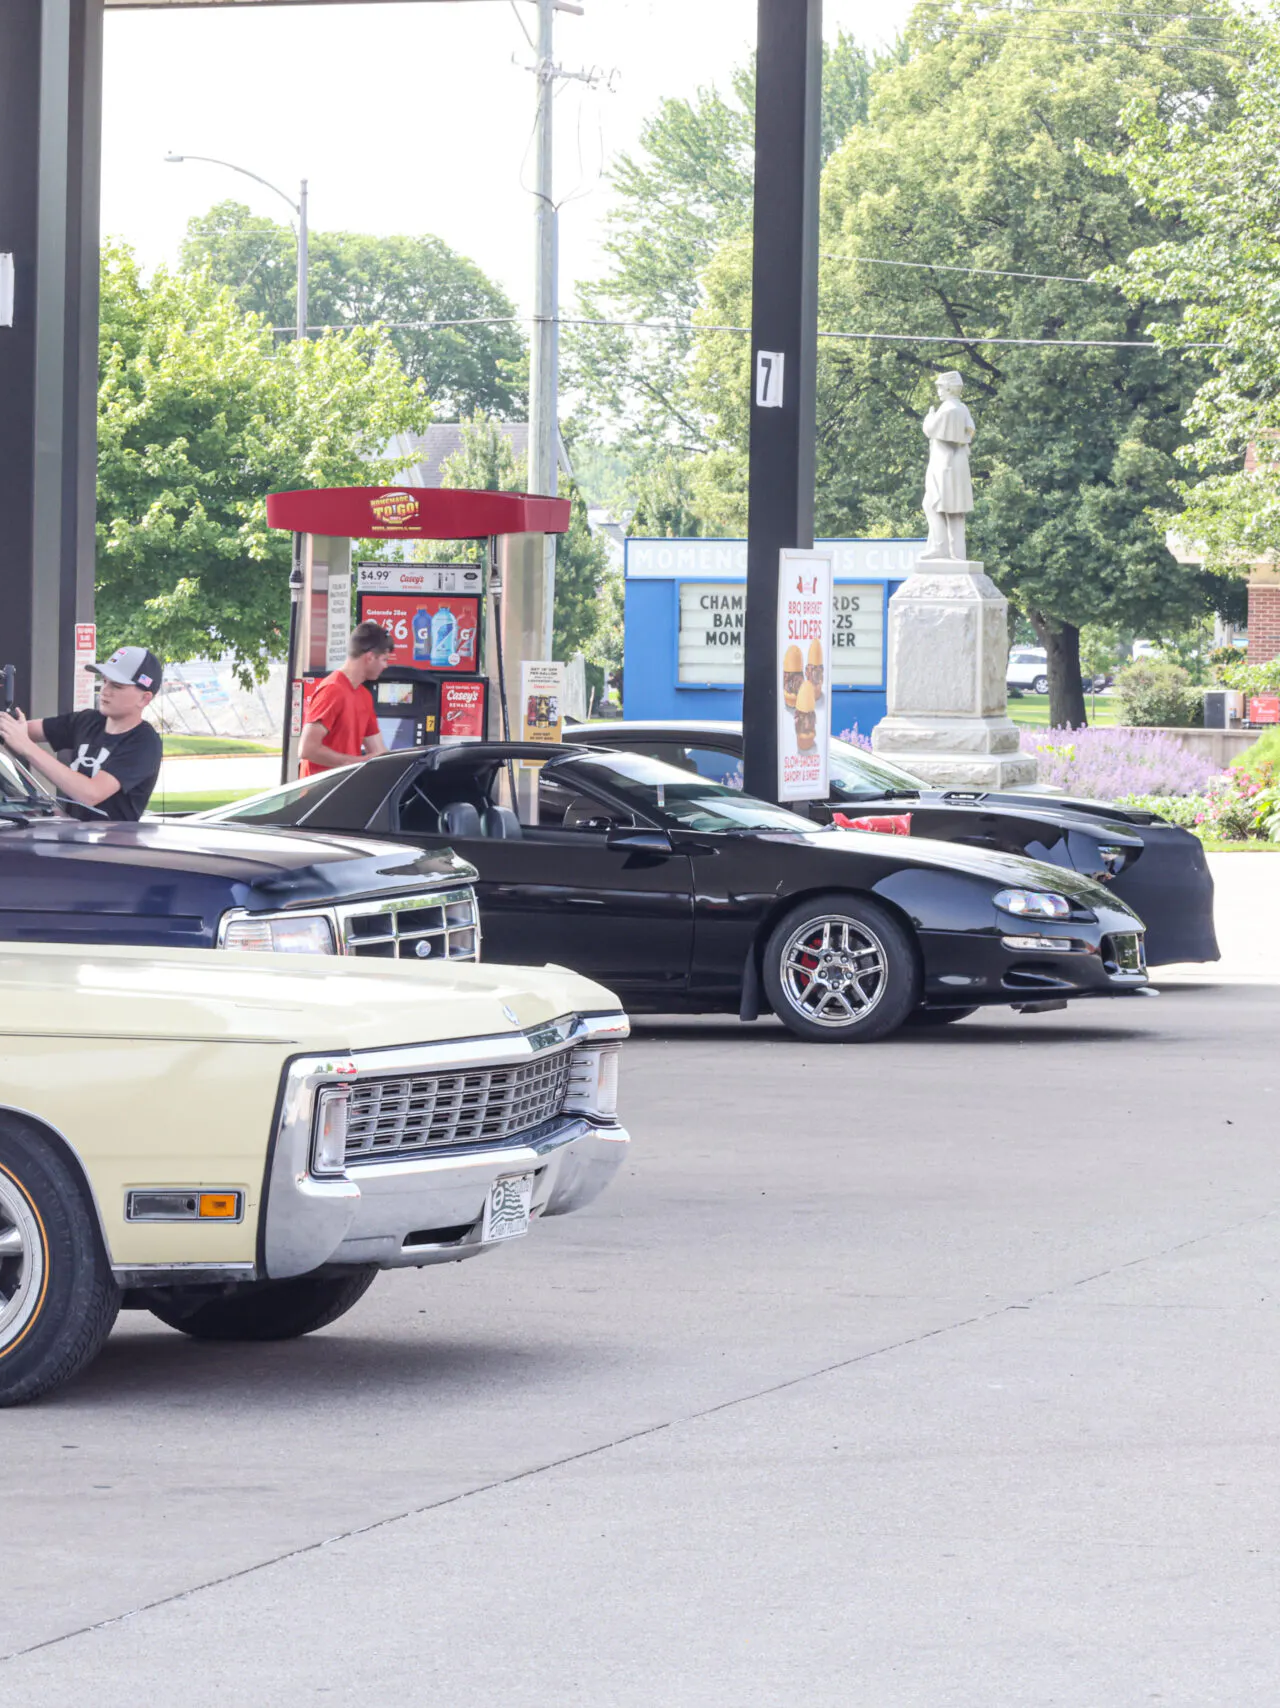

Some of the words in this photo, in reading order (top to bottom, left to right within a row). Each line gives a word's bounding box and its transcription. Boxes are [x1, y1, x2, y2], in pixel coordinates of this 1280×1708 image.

[761, 357, 772, 402] 7
[634, 548, 748, 570] MOMENC
[865, 549, 915, 571] CLU
[400, 574, 424, 584] Casey's
[700, 595, 748, 610] CHAM
[833, 596, 860, 611] RDS
[788, 601, 801, 615] BBQ
[713, 613, 744, 628] BAN
[417, 628, 428, 639] G
[460, 629, 470, 640] G
[788, 619, 822, 640] SLIDERS
[705, 631, 741, 646] MOM
[447, 690, 478, 703] Casey's
[784, 770, 801, 782] SAVORY
[806, 769, 820, 781] SWEET
